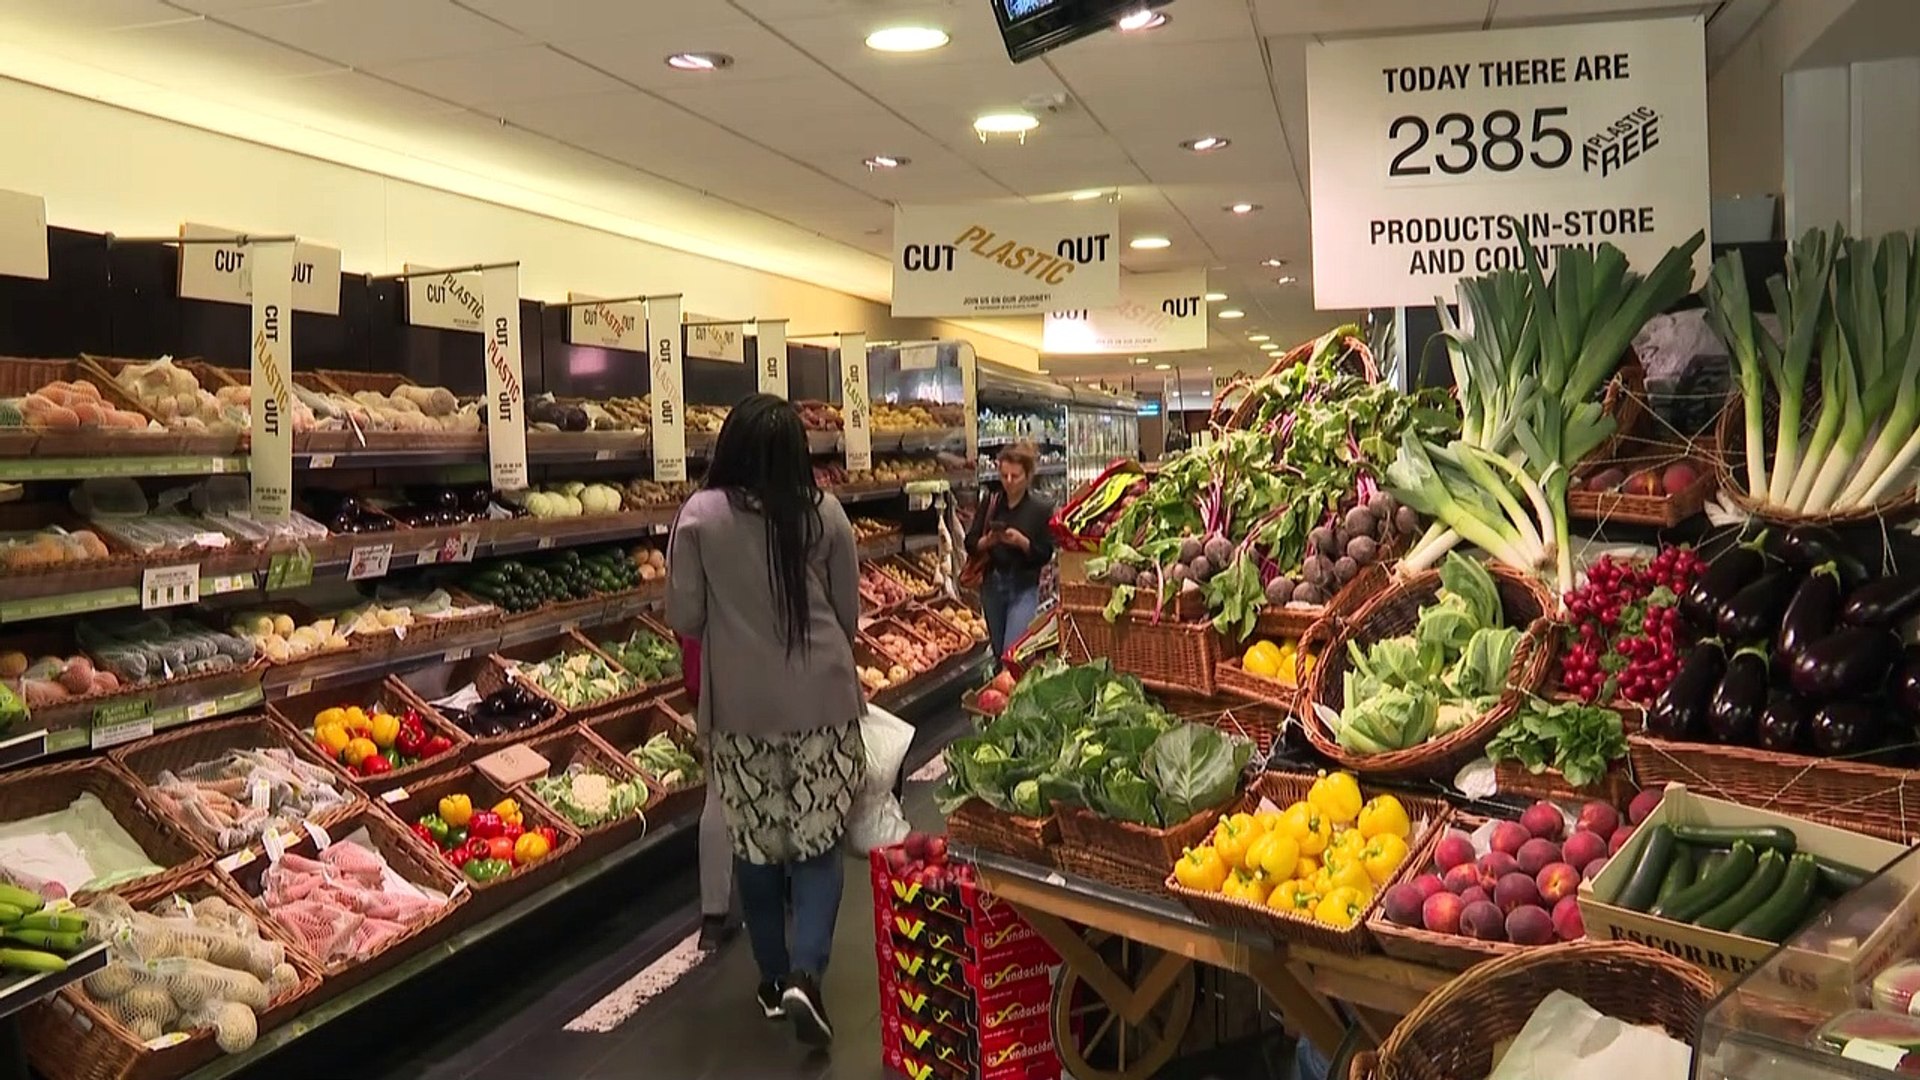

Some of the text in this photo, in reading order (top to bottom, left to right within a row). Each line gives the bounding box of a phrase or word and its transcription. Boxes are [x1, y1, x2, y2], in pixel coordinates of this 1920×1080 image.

[1383, 53, 1630, 93] TODAY THERE ARE
[1389, 106, 1573, 177] 2385
[1587, 105, 1656, 149] PLASTIC
[1582, 115, 1659, 178] FREE
[1370, 206, 1655, 245] PRODUCTS IN-STORE
[214, 249, 245, 273] CUT
[903, 224, 1110, 286] CUT PLASTIC OUT
[1409, 241, 1607, 275] AND COUN
[427, 274, 484, 319] CUT PLASTIC
[1162, 296, 1200, 318] OUT
[264, 305, 279, 343] CUT
[495, 317, 508, 347] CUT
[584, 309, 598, 326] CUT
[487, 338, 520, 403] PLASTIC
[659, 339, 672, 365] CUT
[767, 356, 778, 380] CUT
[254, 330, 289, 413] PLASTIC
[850, 364, 860, 384] CUT
[264, 398, 279, 437] OUT
[499, 391, 512, 422] OUT
[661, 399, 674, 426] OUT
[1608, 924, 1820, 992] ESCORREES
